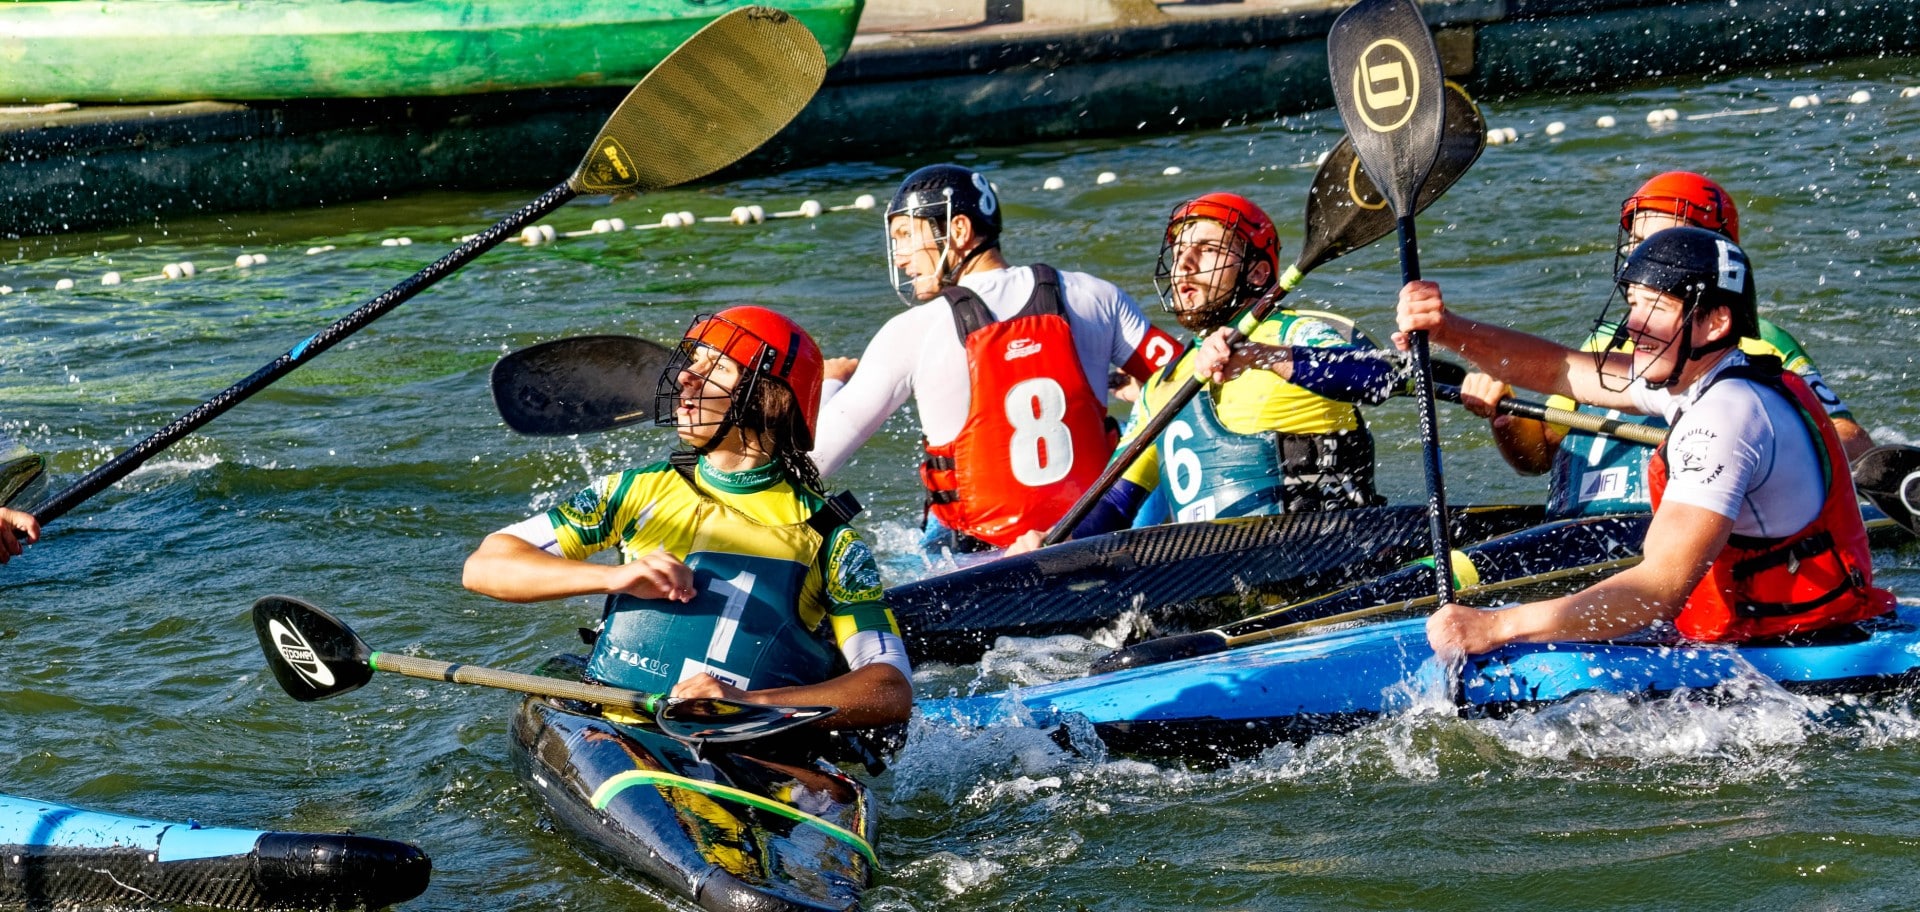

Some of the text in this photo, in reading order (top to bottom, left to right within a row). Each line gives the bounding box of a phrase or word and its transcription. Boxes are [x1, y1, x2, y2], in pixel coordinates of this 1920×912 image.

[971, 172, 996, 216] 8
[1715, 239, 1747, 294] 6
[1005, 377, 1074, 487] 8
[1164, 420, 1203, 505] 6
[708, 570, 757, 664] 1
